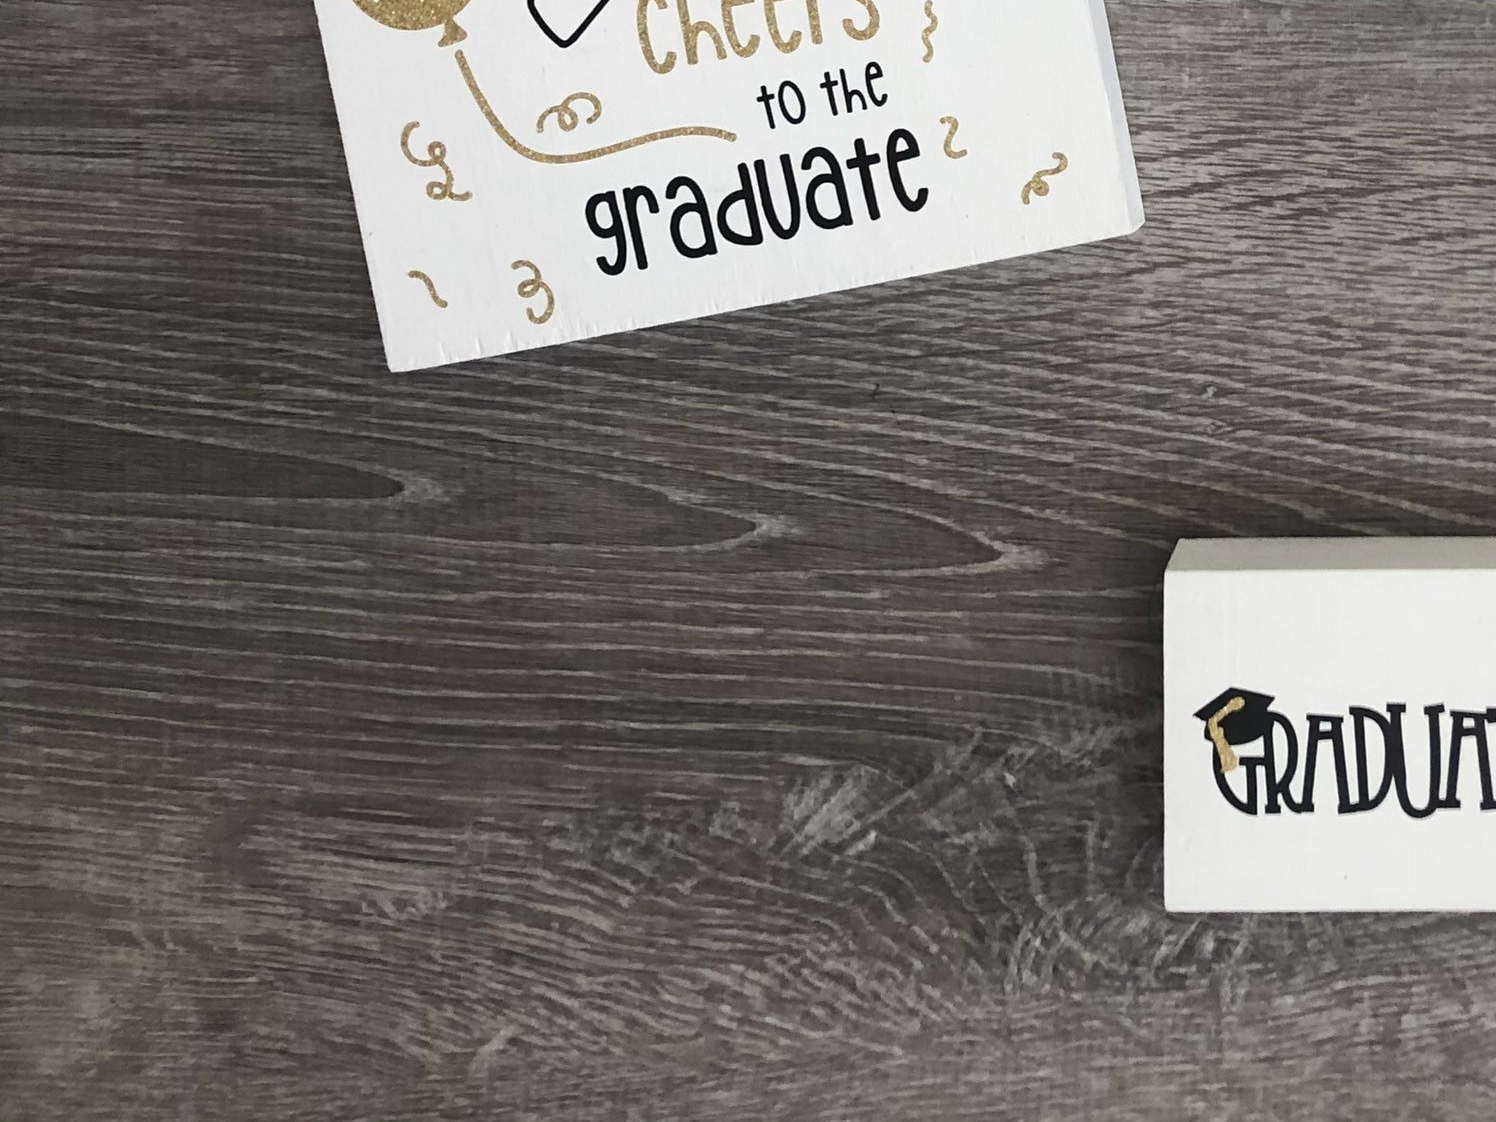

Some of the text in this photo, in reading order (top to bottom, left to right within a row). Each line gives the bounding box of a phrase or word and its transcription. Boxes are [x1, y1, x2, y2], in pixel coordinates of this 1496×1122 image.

[756, 60, 890, 130] to the
[584, 127, 929, 276] graduate
